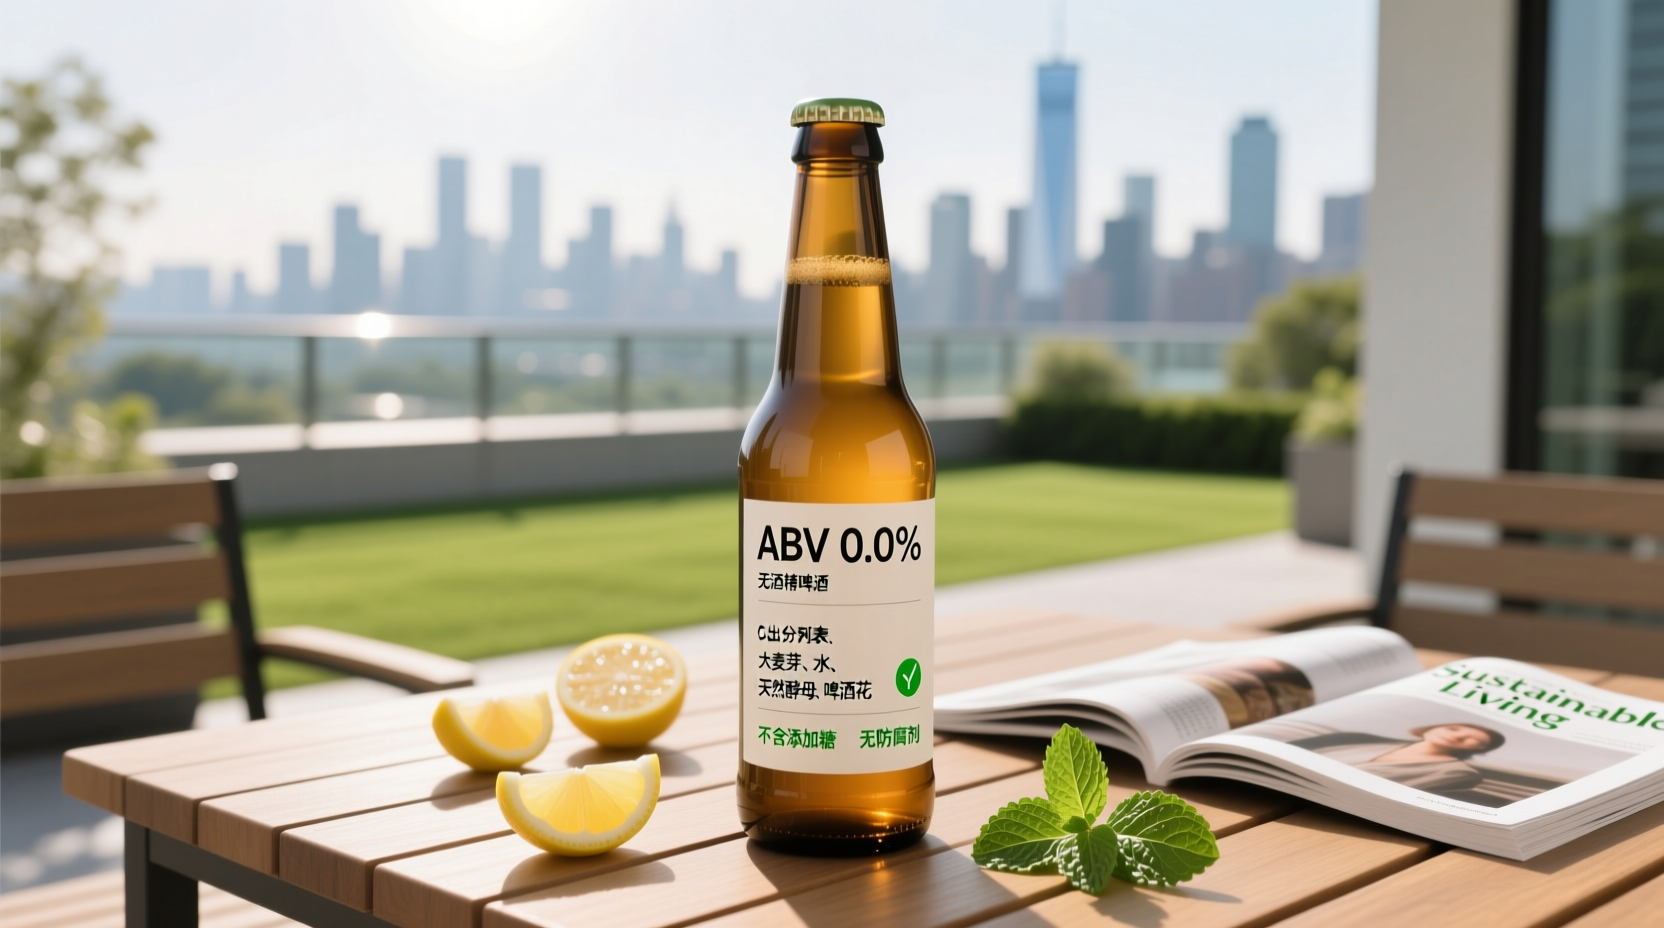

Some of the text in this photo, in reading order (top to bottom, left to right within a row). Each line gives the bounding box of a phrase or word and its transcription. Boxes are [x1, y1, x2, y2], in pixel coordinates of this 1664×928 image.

[757, 525, 921, 563] ABV 0.0%
[1439, 681, 1571, 730] Living
